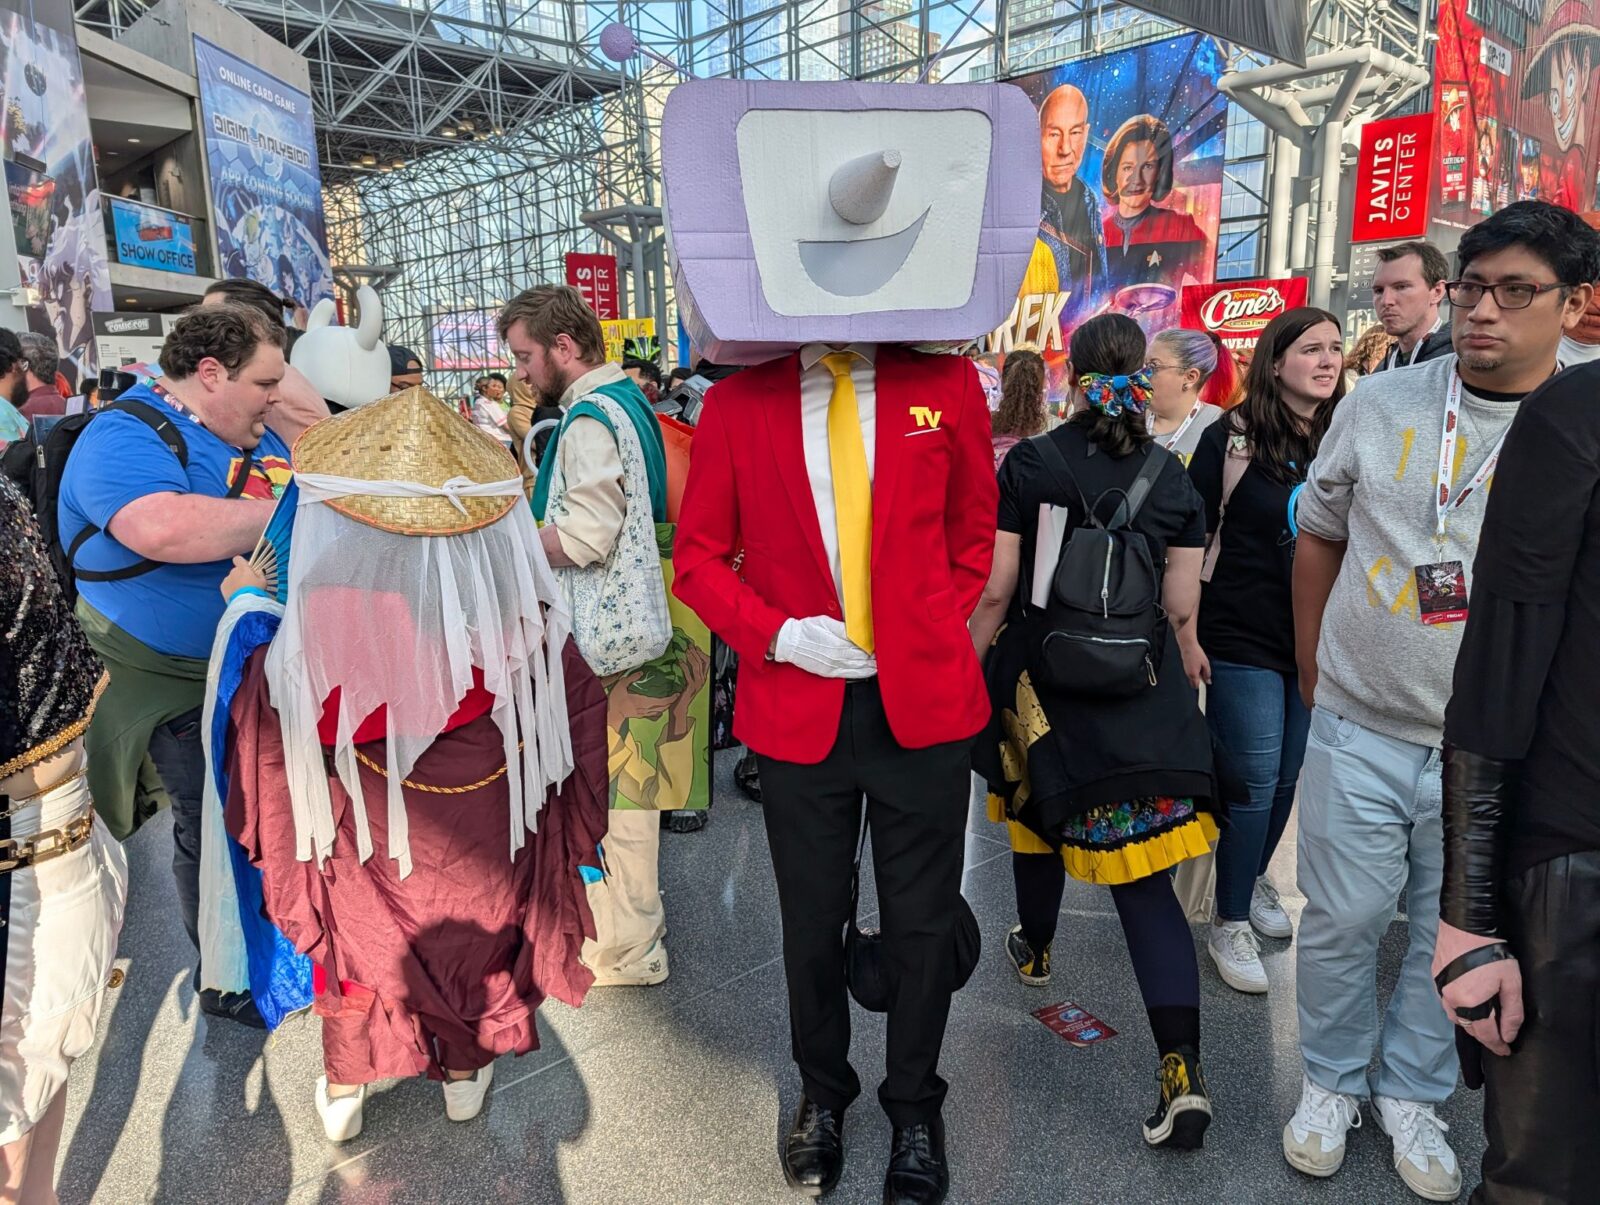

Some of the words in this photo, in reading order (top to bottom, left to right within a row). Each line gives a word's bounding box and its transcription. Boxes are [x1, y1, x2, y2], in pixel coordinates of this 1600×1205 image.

[219, 66, 252, 92] ONLINE
[252, 83, 273, 102] CARD
[274, 94, 296, 113] GAME
[221, 166, 241, 188] APP
[243, 174, 284, 200] COMING
[1368, 137, 1394, 223] JAVITS
[1395, 133, 1417, 220] CENTER
[121, 242, 157, 261] SHOW
[157, 249, 194, 269] OFFICE
[597, 268, 611, 320] NTER
[1205, 287, 1281, 329] Cane's
[909, 406, 942, 429] TV
